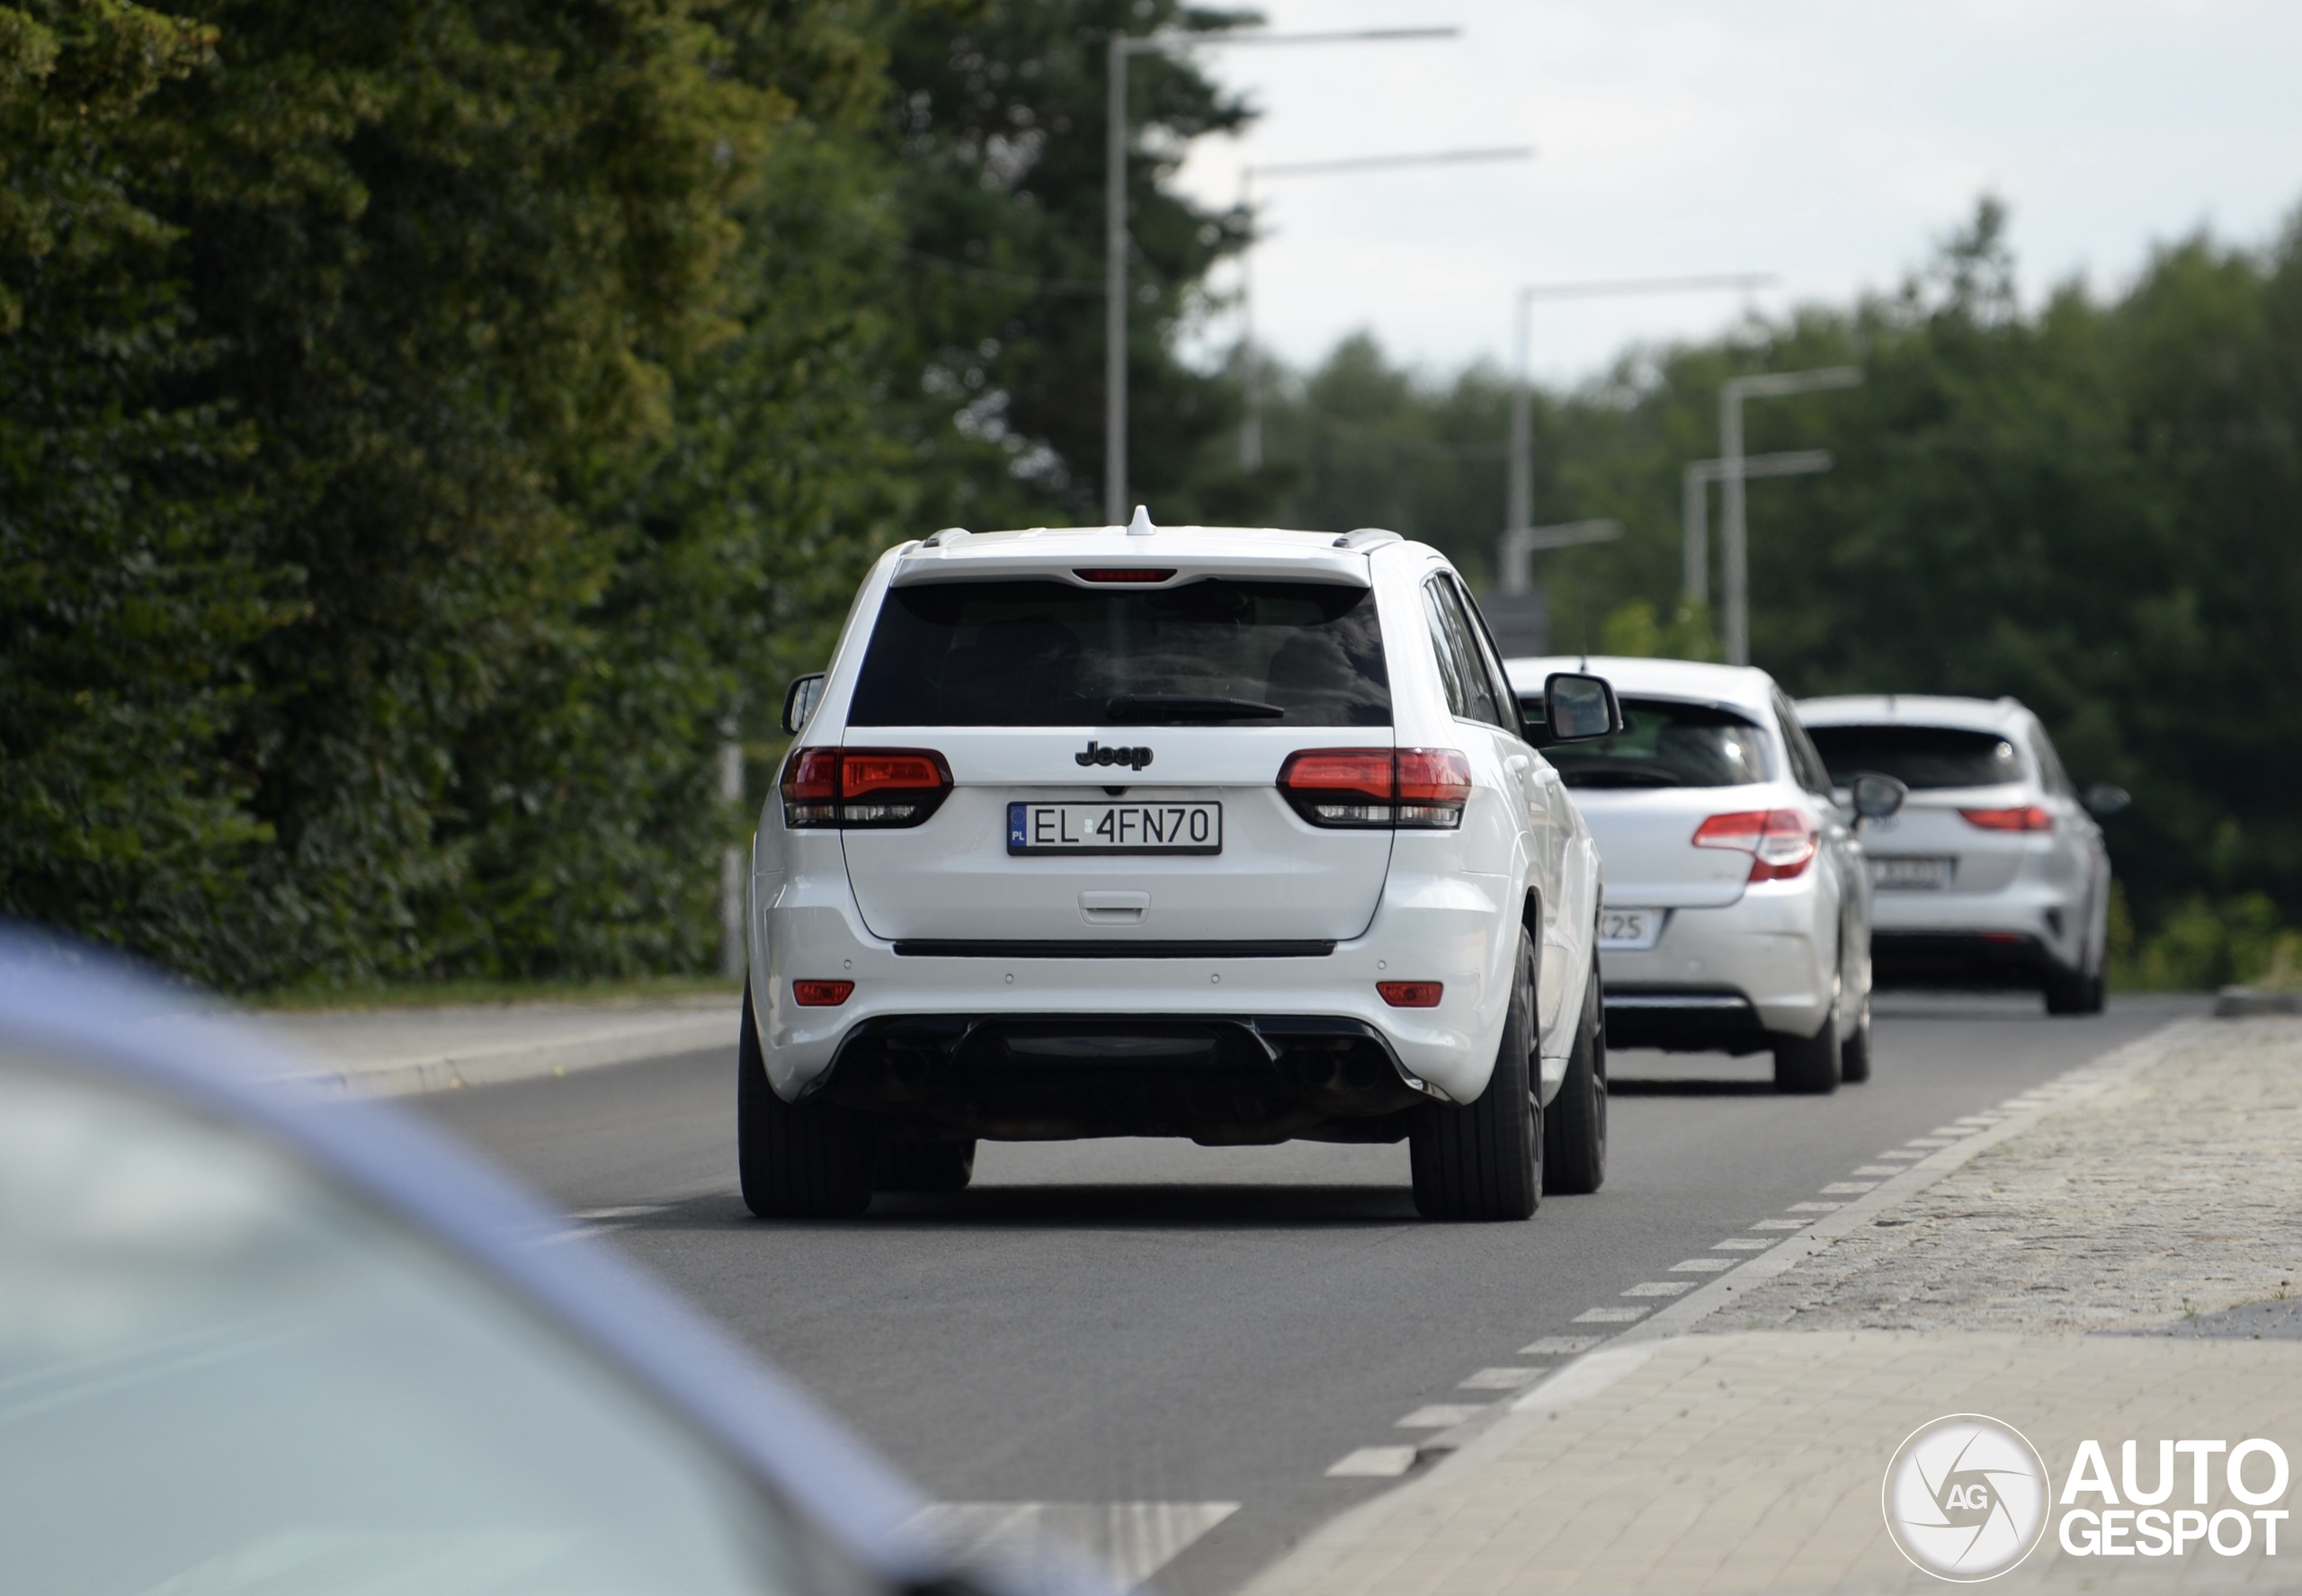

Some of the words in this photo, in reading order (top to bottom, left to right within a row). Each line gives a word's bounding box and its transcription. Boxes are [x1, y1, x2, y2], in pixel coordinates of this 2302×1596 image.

[1075, 740, 1154, 771] Jeep
[1012, 831, 1025, 841] PL
[1035, 809, 1079, 843] EL
[1096, 808, 1209, 843] 4FN70
